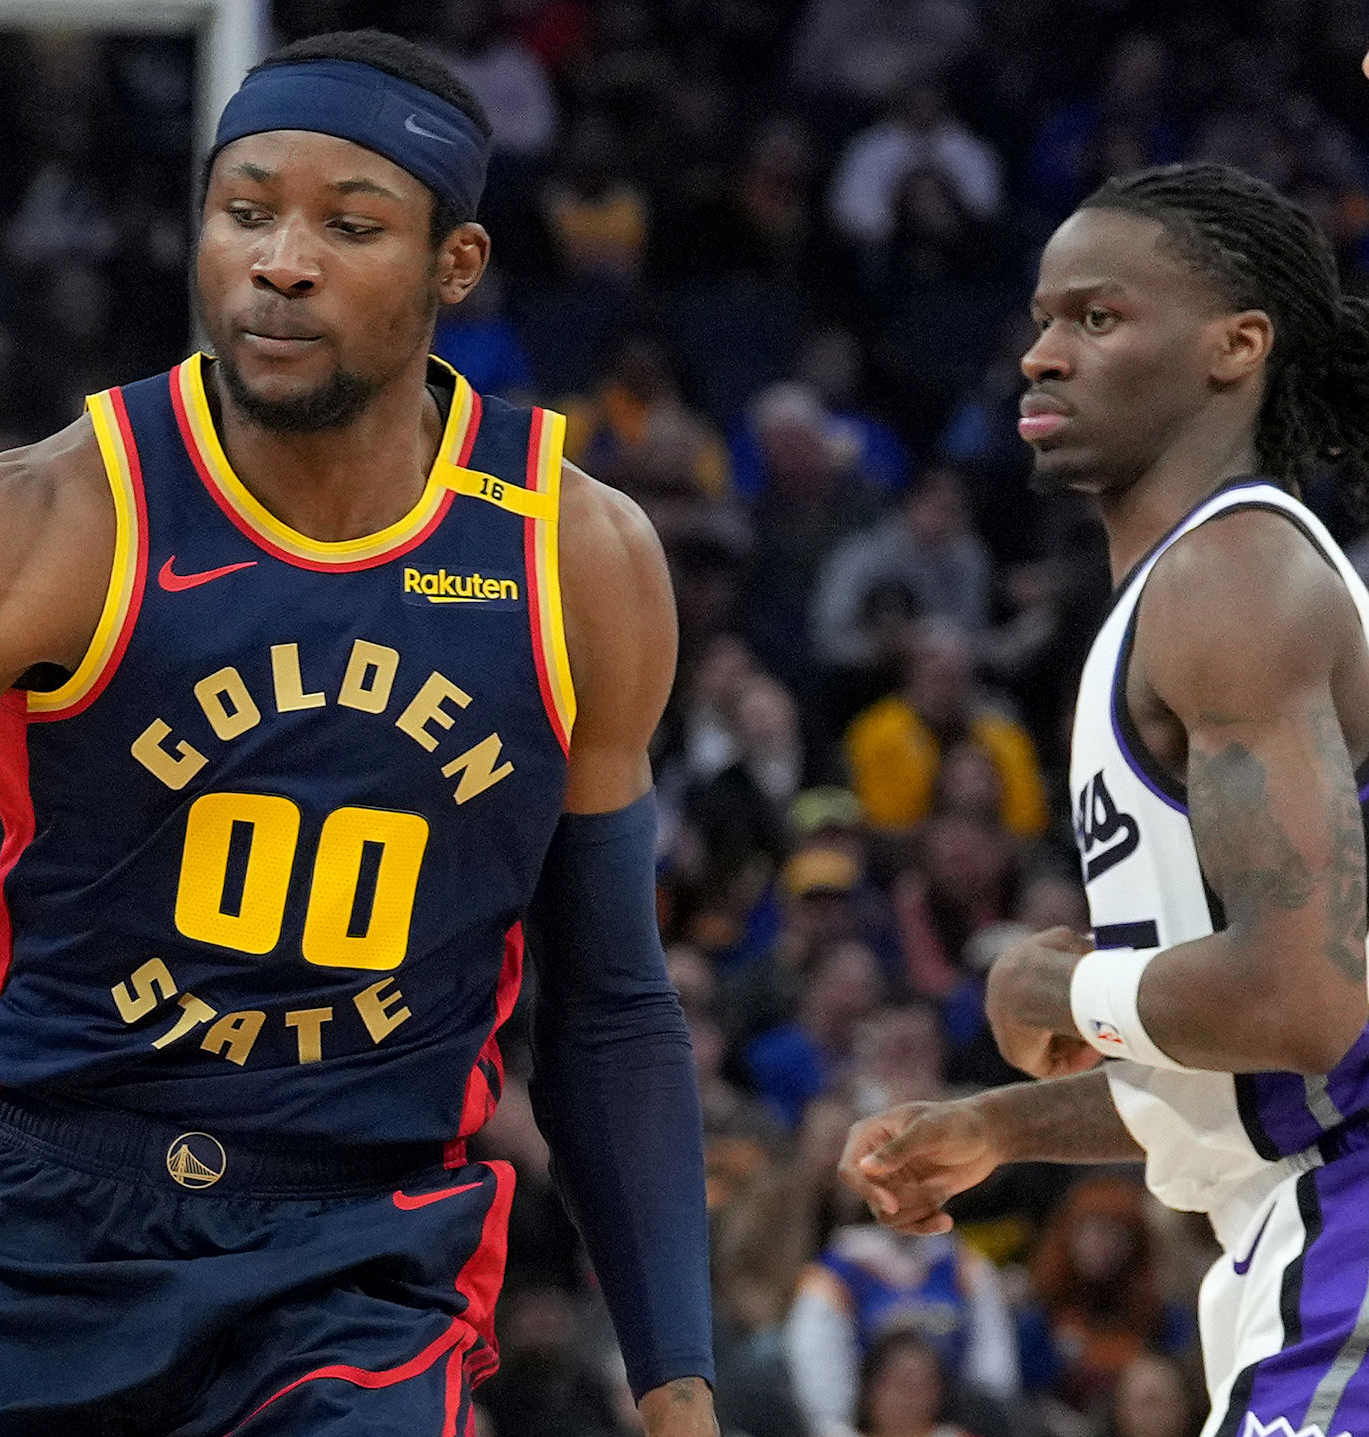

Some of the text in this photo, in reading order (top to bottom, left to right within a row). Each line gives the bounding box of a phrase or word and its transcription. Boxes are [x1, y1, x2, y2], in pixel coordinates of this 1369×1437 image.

[480, 478, 505, 502] 16
[404, 567, 519, 602] Rakuten
[130, 638, 515, 806] GOLDEN
[174, 792, 431, 972] 00
[111, 957, 412, 1066] STATE
